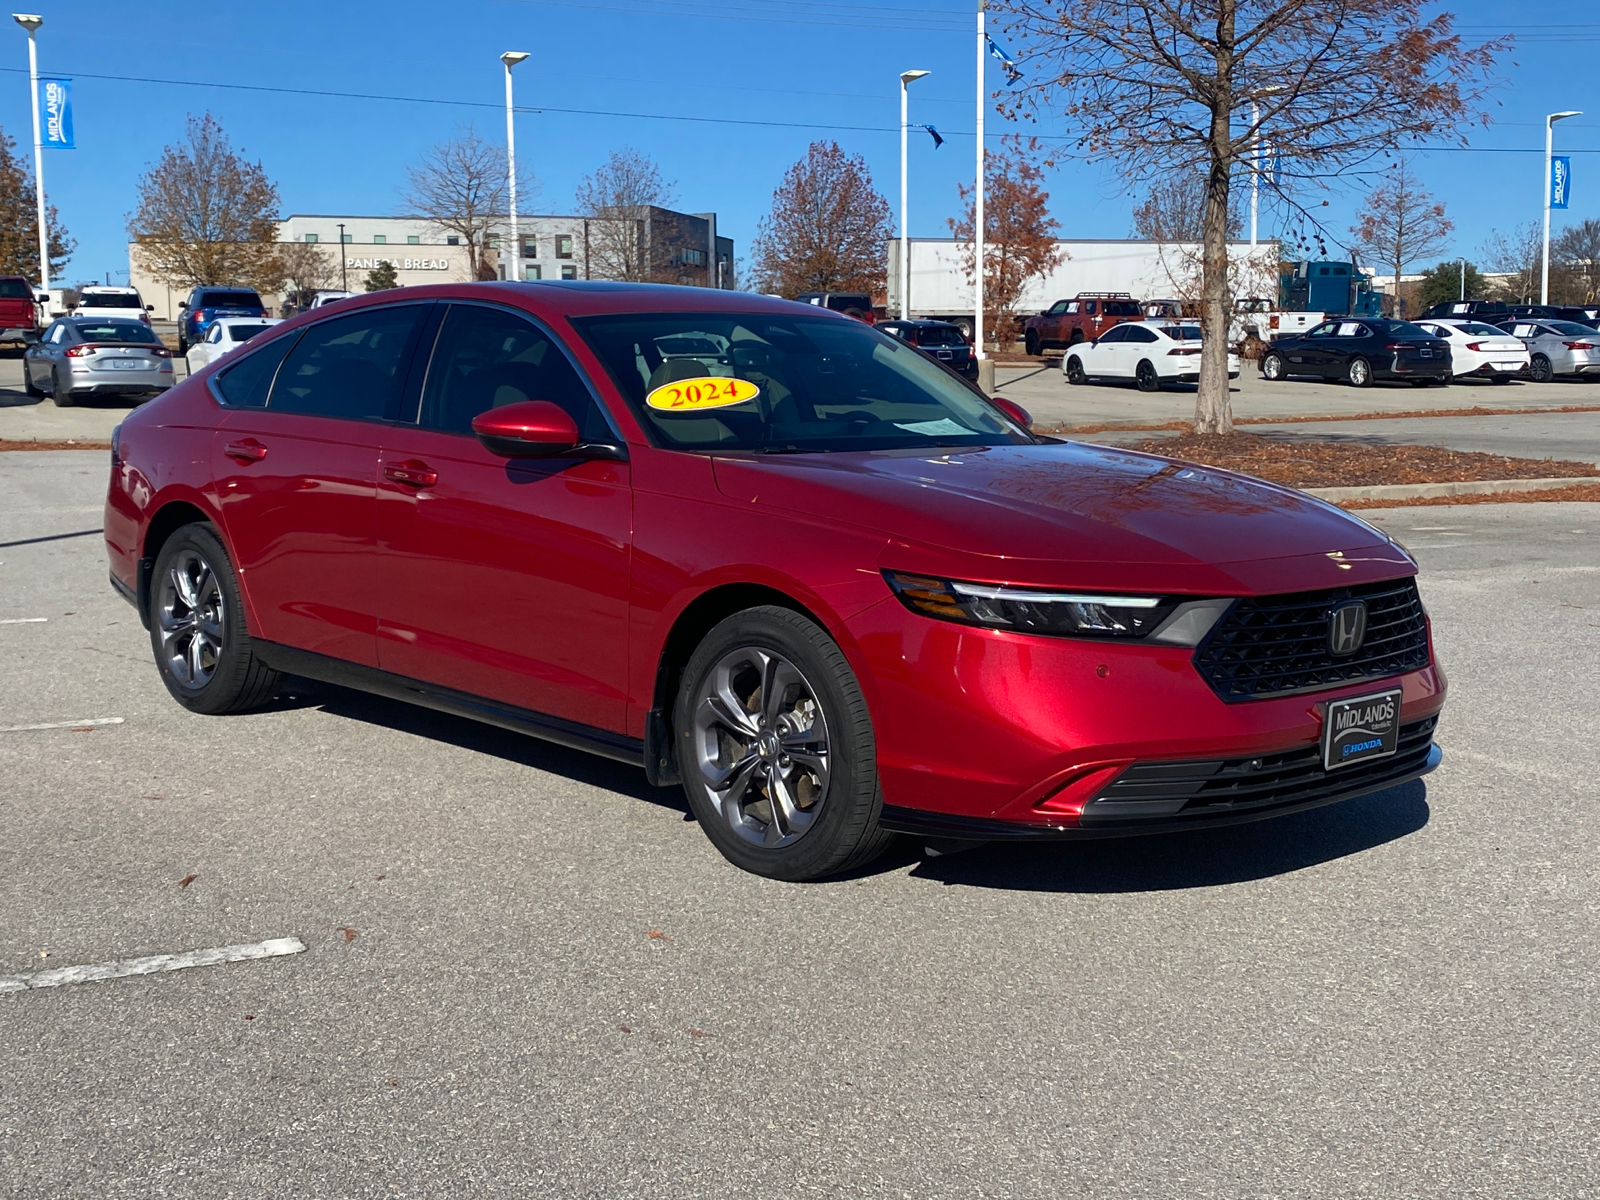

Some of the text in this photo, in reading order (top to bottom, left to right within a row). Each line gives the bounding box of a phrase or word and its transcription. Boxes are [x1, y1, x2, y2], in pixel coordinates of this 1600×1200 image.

[46, 83, 60, 142] MIDLANDS
[404, 258, 449, 270] BREAD
[667, 380, 738, 408] 2024
[1336, 702, 1395, 731] MIDLANDS
[1350, 739, 1382, 753] HONDA
